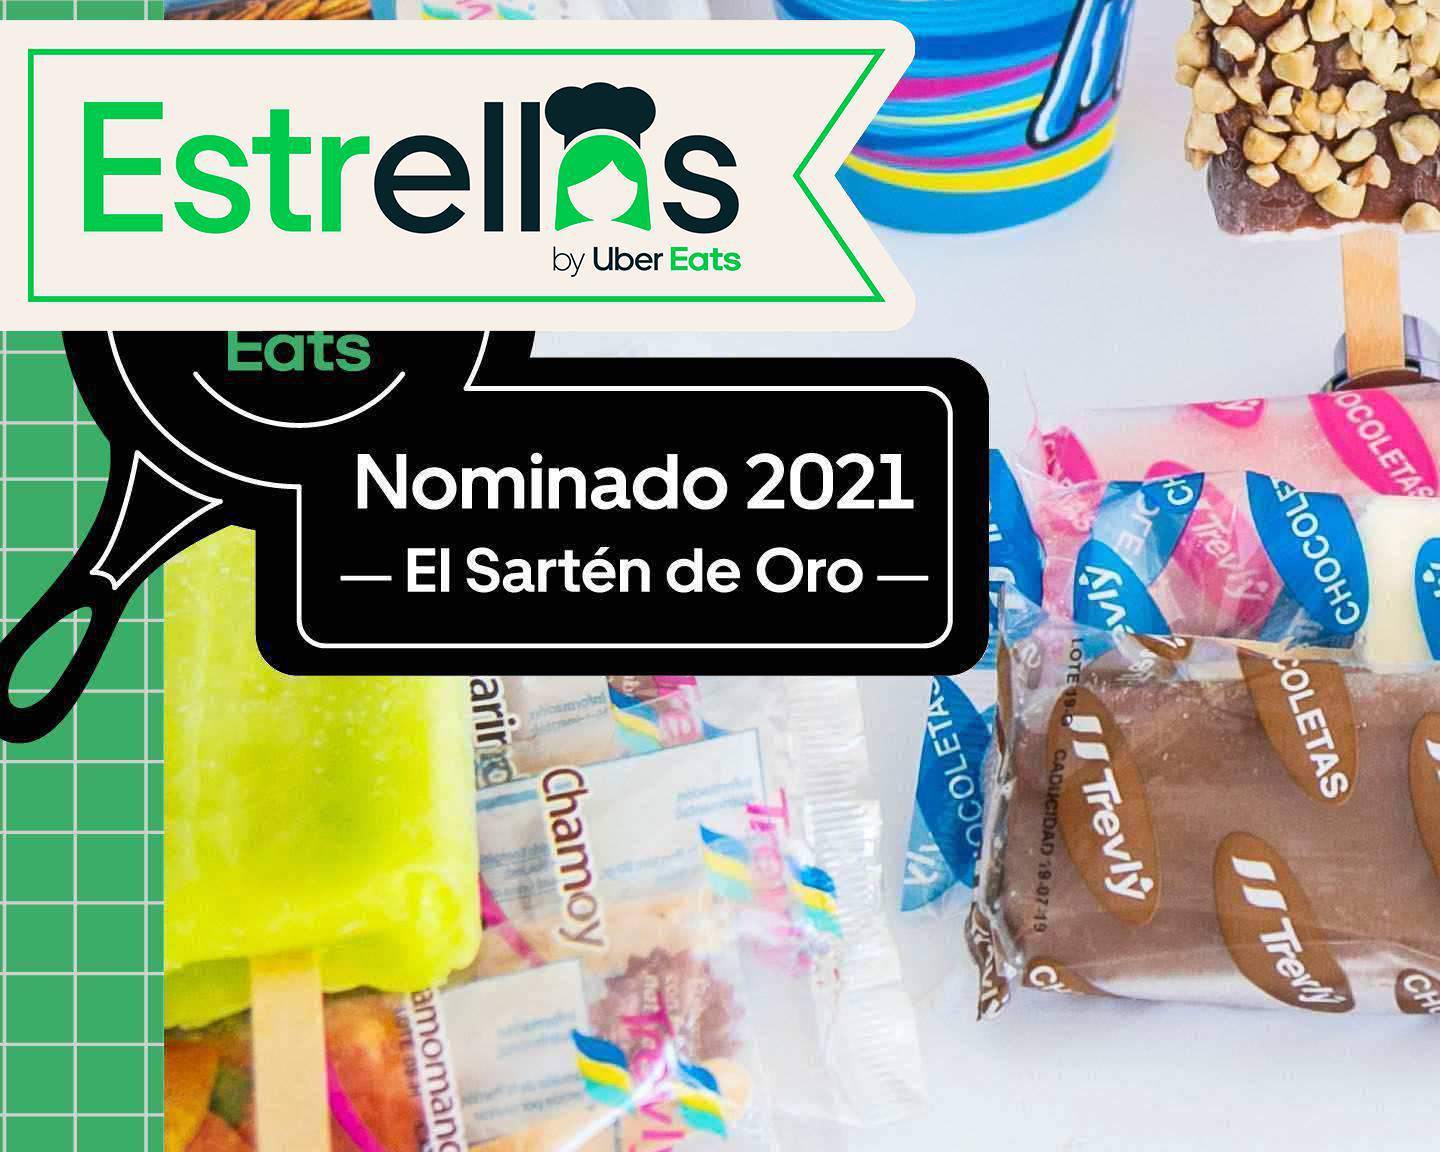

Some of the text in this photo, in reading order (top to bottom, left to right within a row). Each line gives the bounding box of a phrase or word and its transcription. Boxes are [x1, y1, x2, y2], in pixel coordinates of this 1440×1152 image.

[1334, 390, 1435, 497] OCOLETAS
[1271, 477, 1361, 626] CHOCOLE
[1066, 638, 1084, 684] LOTE
[1040, 749, 1067, 857] CADUCIDAD
[1082, 767, 1155, 900] Trevly
[542, 767, 606, 948] Chamoy
[1258, 916, 1346, 1006] Trevly
